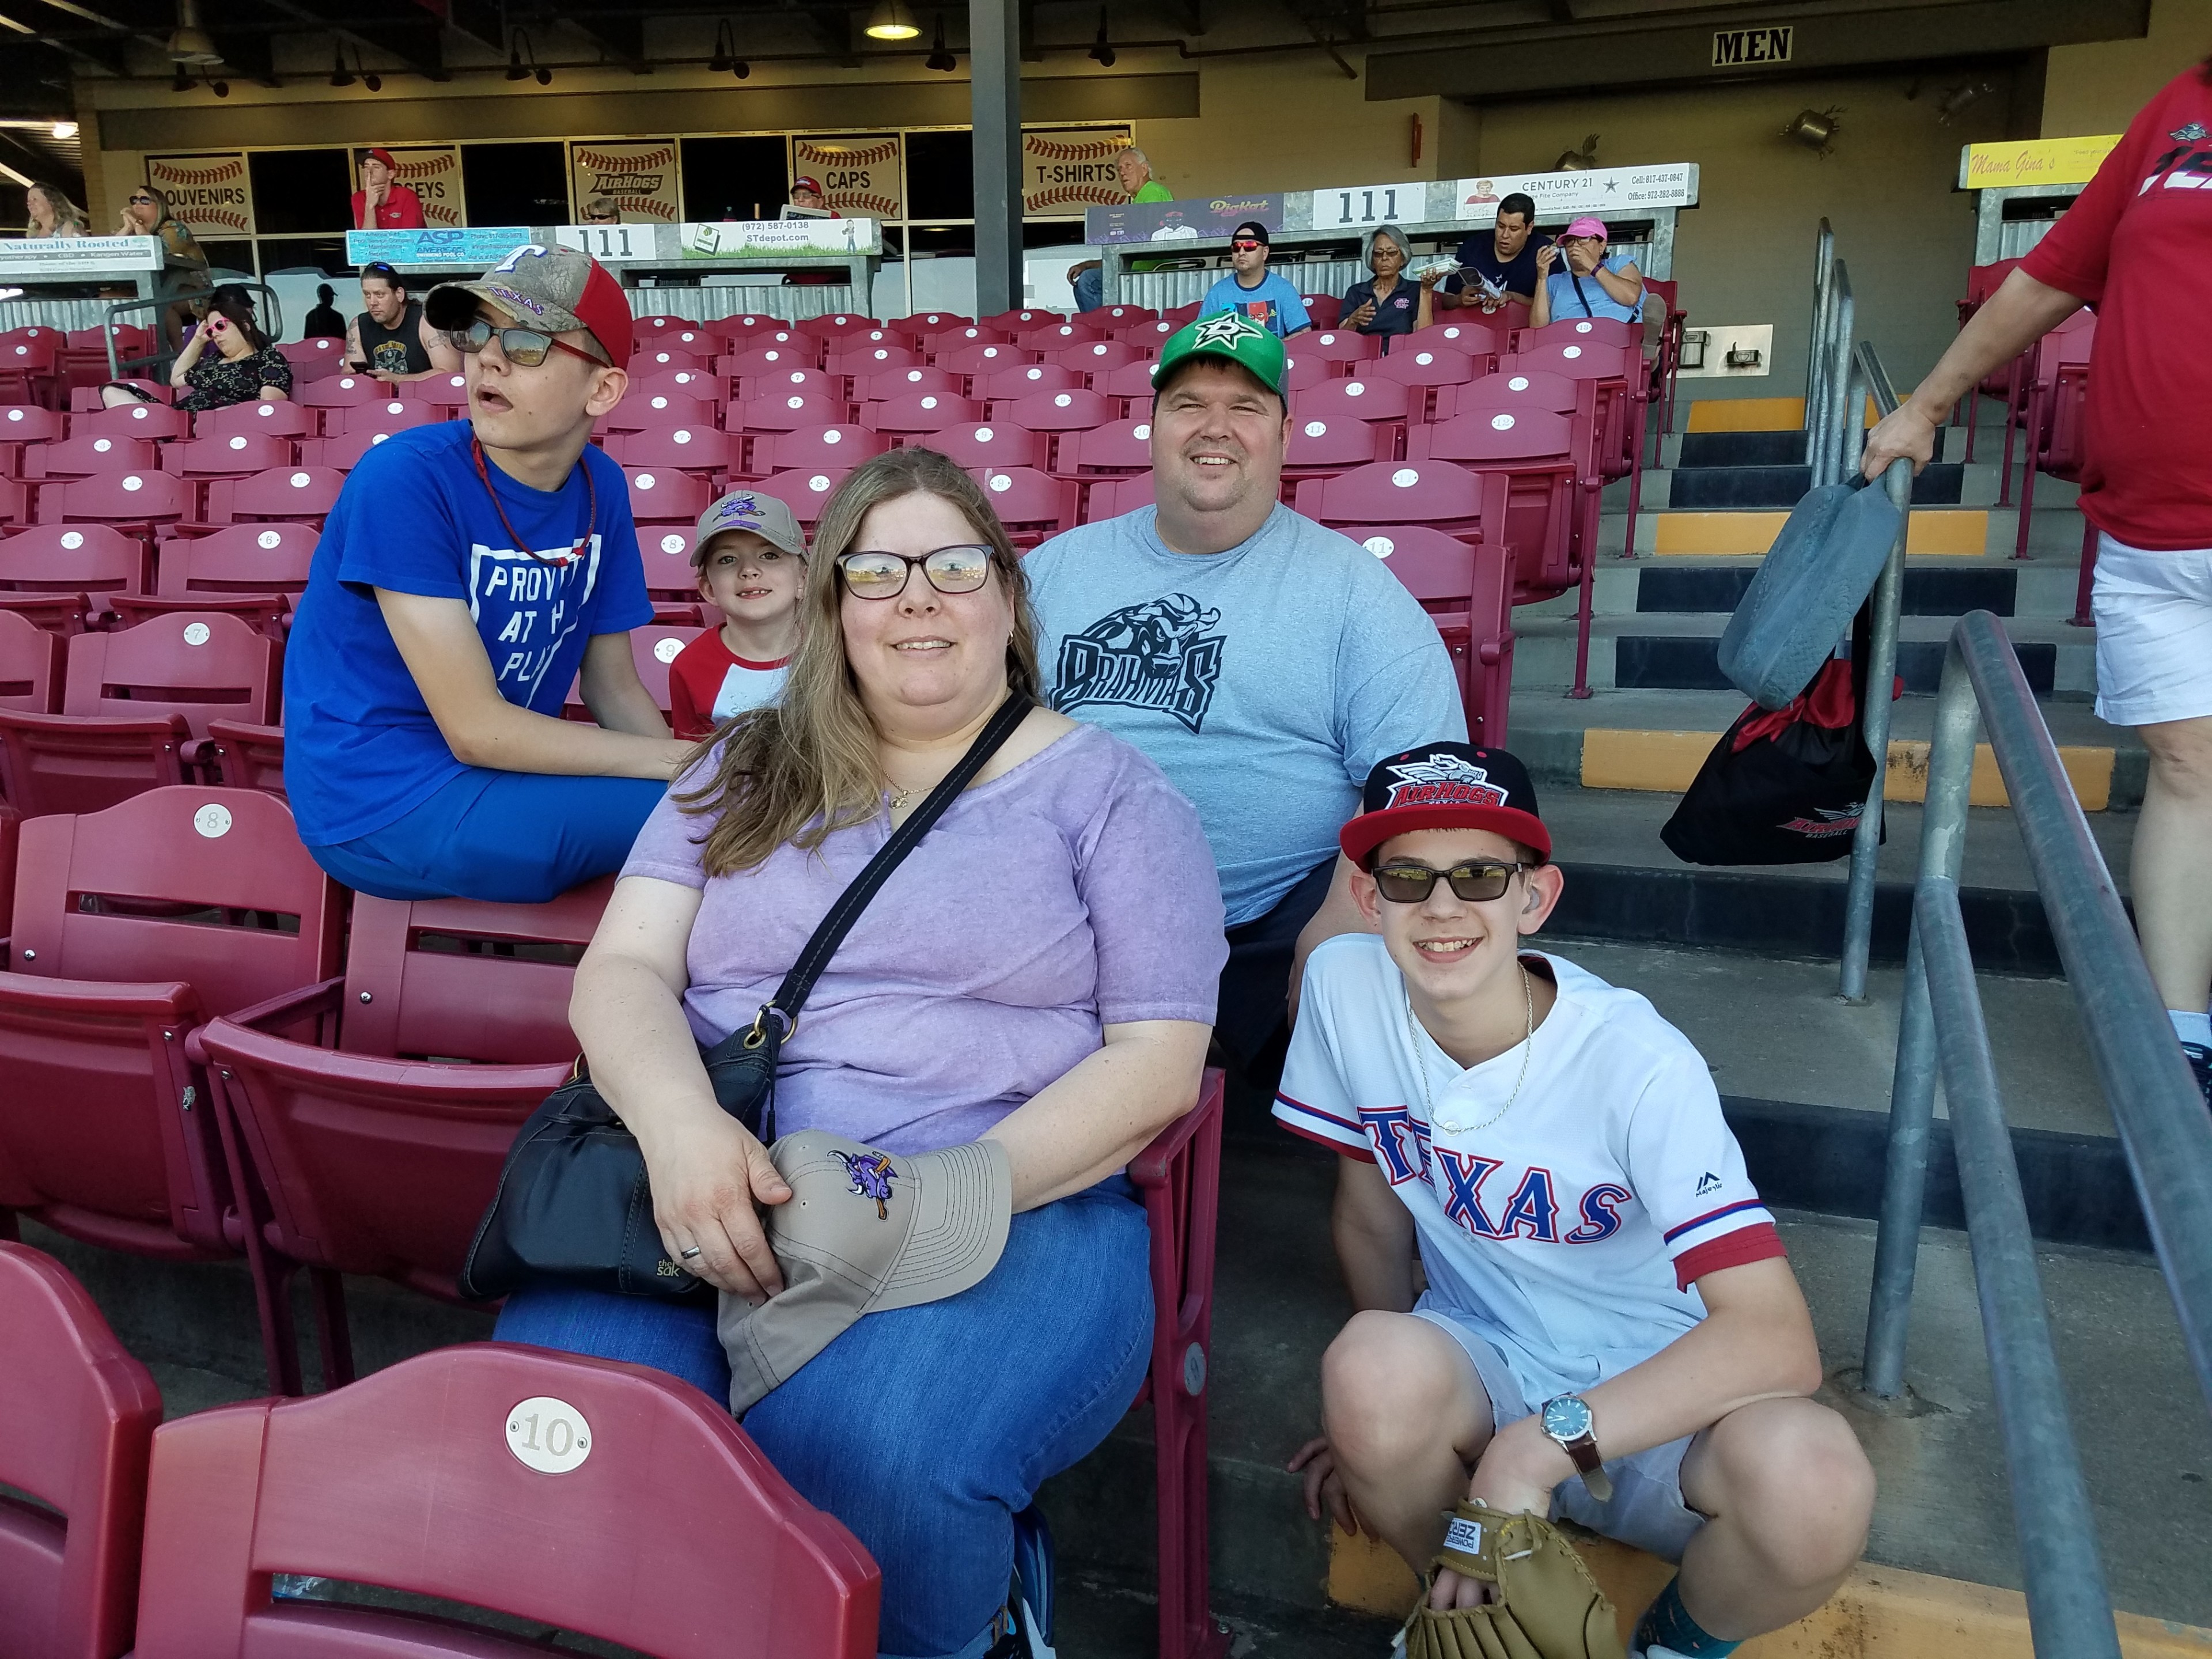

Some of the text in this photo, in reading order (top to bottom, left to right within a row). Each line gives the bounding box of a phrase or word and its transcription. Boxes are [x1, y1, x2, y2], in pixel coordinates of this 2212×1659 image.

[1715, 29, 1790, 65] MEN
[1972, 154, 2010, 174] Mama
[826, 171, 871, 190] CAPS
[1036, 164, 1116, 183] T-SHIRTS
[1632, 173, 1683, 184] Cell: 817-437-0847
[595, 175, 660, 190] AIRHOGS
[1522, 177, 1593, 191] CENTURY 21
[165, 188, 245, 206] OUVENIRS
[1628, 189, 1684, 200] Office: 972-282-8888
[1339, 189, 1399, 224] 111
[742, 222, 809, 232] (972) 587-0138
[3, 239, 128, 250] Naturally Rooted
[418, 231, 464, 244] ASP
[578, 229, 633, 257] 111
[747, 234, 809, 243] STdepot.com
[494, 245, 547, 273] T
[486, 287, 545, 316] TEXAS
[69, 536, 76, 544] 5
[669, 539, 676, 549] 8
[1370, 542, 1385, 554] 11
[194, 628, 201, 639] 7
[498, 611, 537, 643] AT
[666, 645, 675, 657] 9
[1050, 635, 1228, 733] BRAHMAS
[1393, 782, 1502, 807] AIRHOGS
[207, 812, 218, 828] 8
[1805, 830, 1847, 839] BASEBALL
[1357, 1105, 1632, 1244] TEXAS
[657, 1261, 680, 1277] sak
[658, 1259, 672, 1267] the
[521, 1414, 574, 1456] 10
